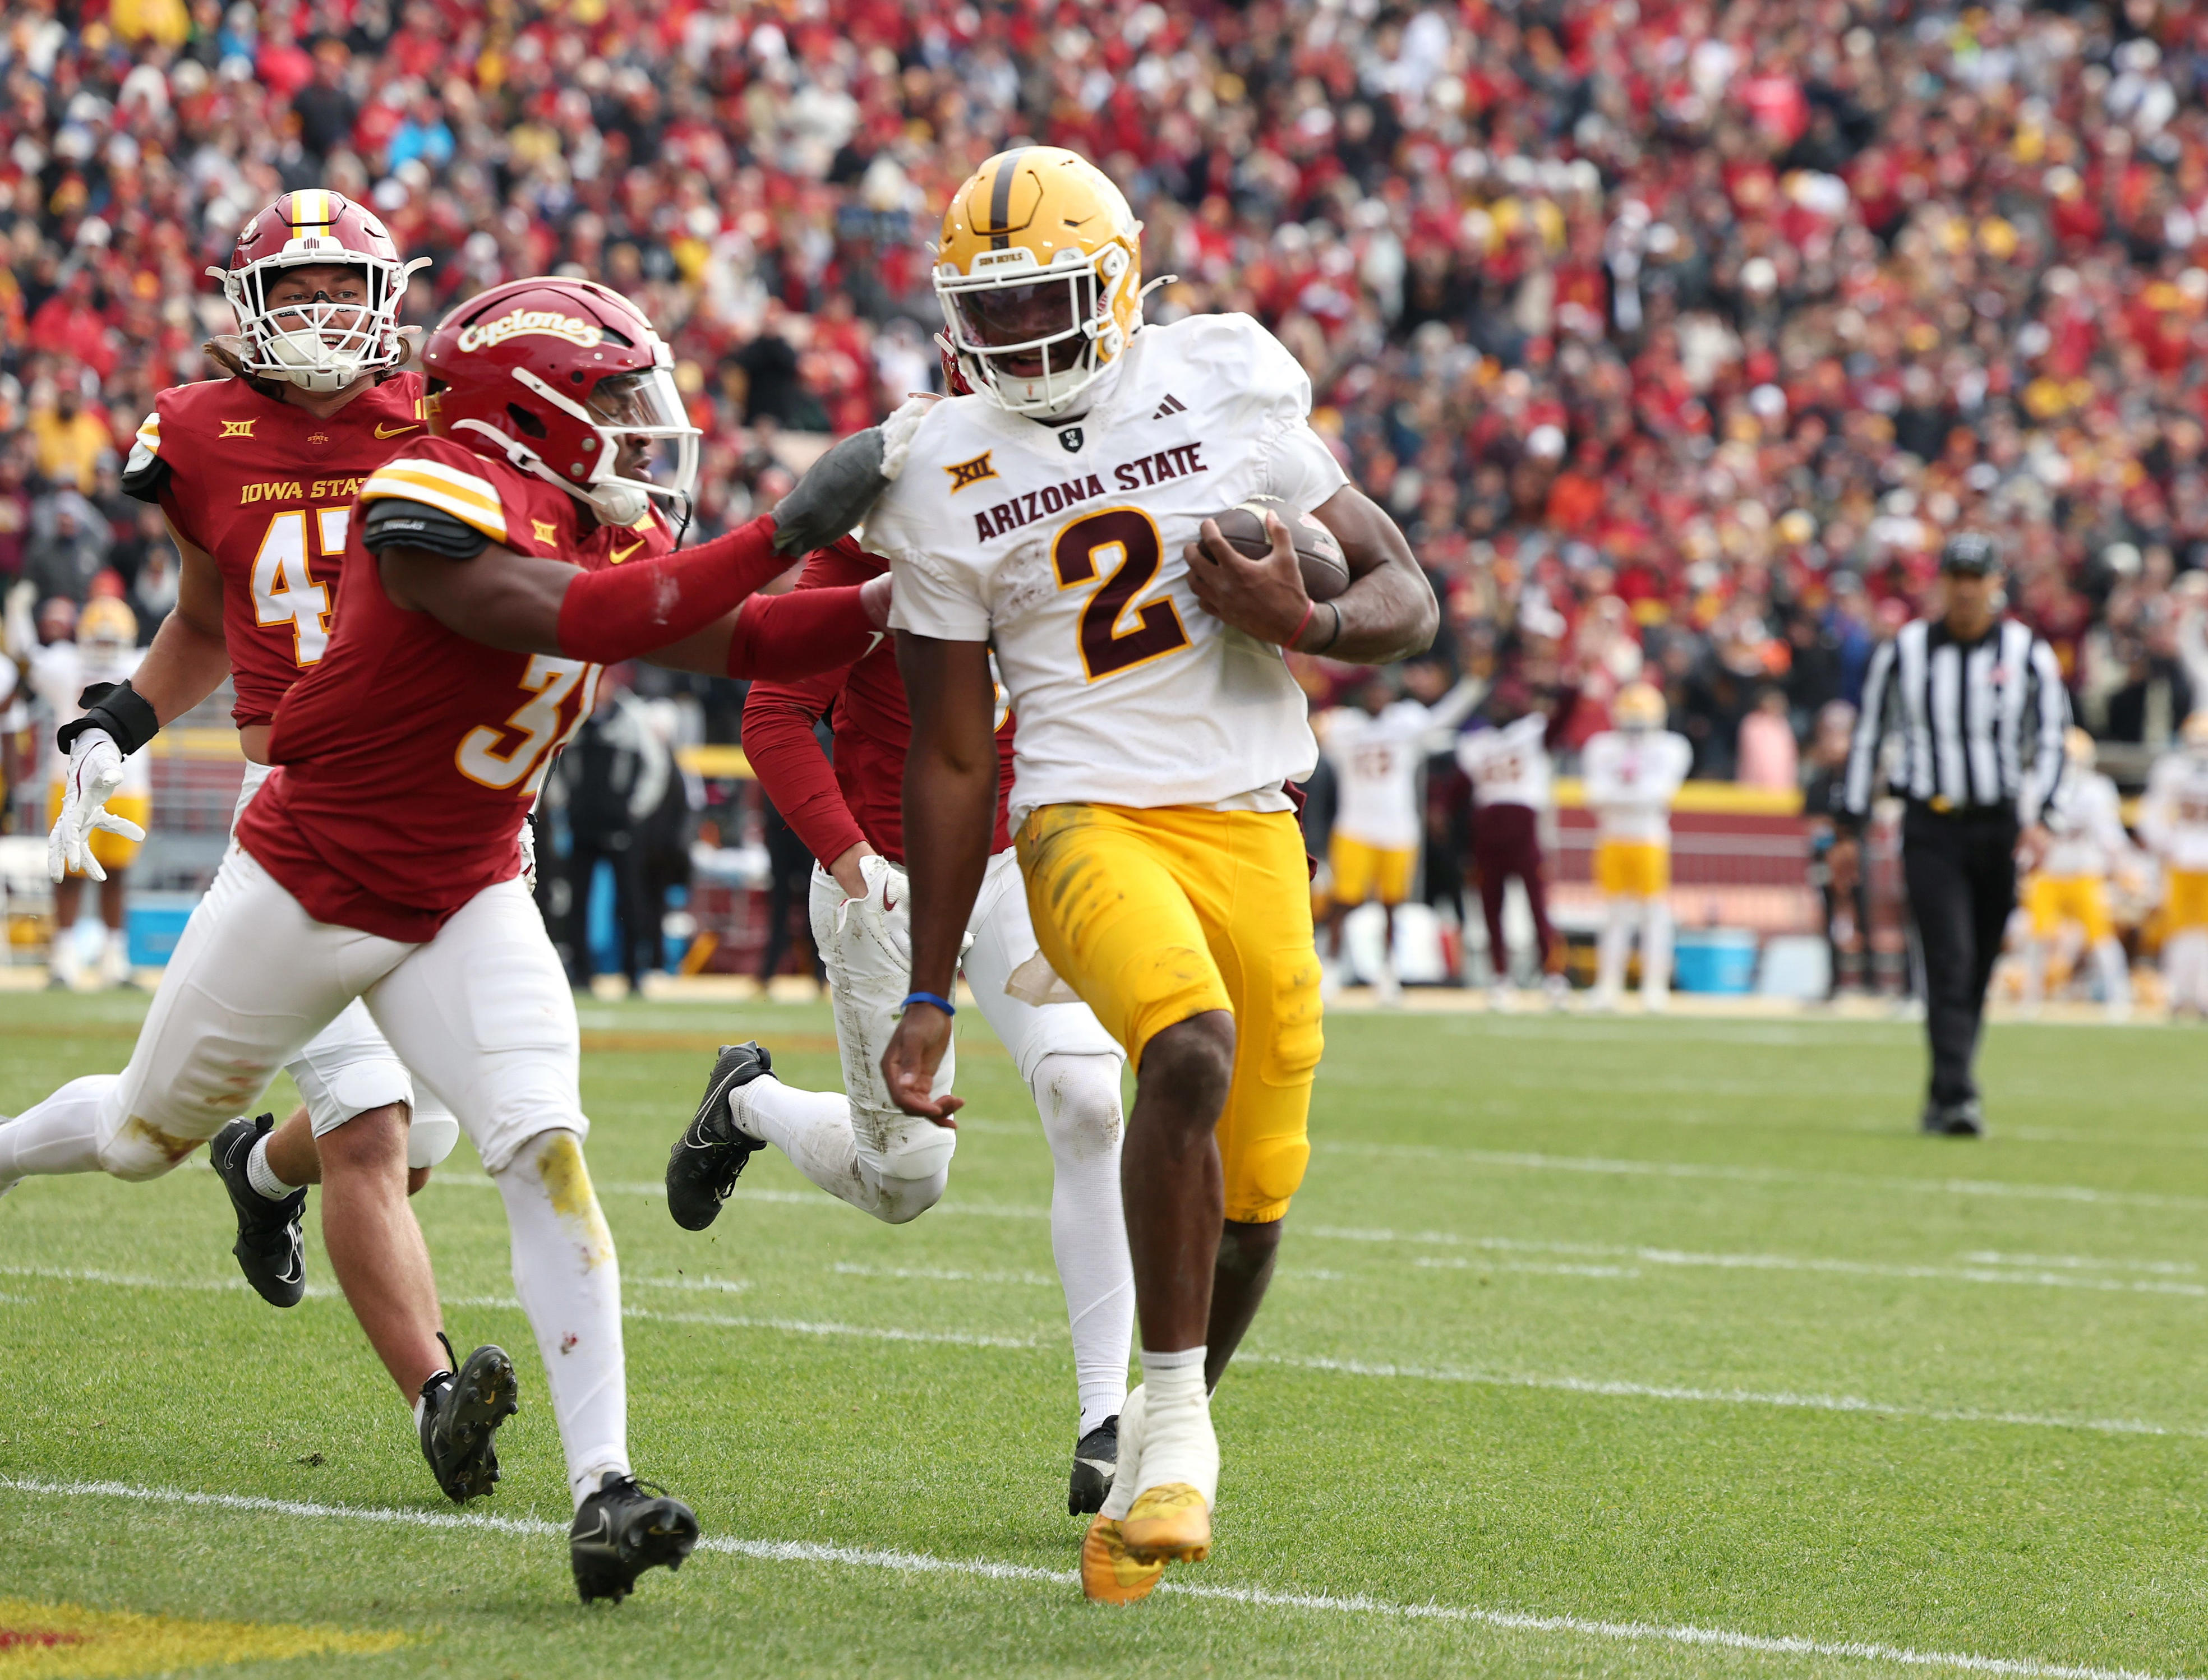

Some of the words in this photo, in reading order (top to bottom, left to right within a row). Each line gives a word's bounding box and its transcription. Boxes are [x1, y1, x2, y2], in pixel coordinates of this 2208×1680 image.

[457, 308, 604, 353] Cyclones
[218, 419, 256, 437] XII
[240, 482, 303, 504] IOWA
[943, 449, 1000, 496] XII
[974, 474, 1106, 543] ARIZONA
[1114, 441, 1208, 491] STATE
[1050, 505, 1193, 685] 2
